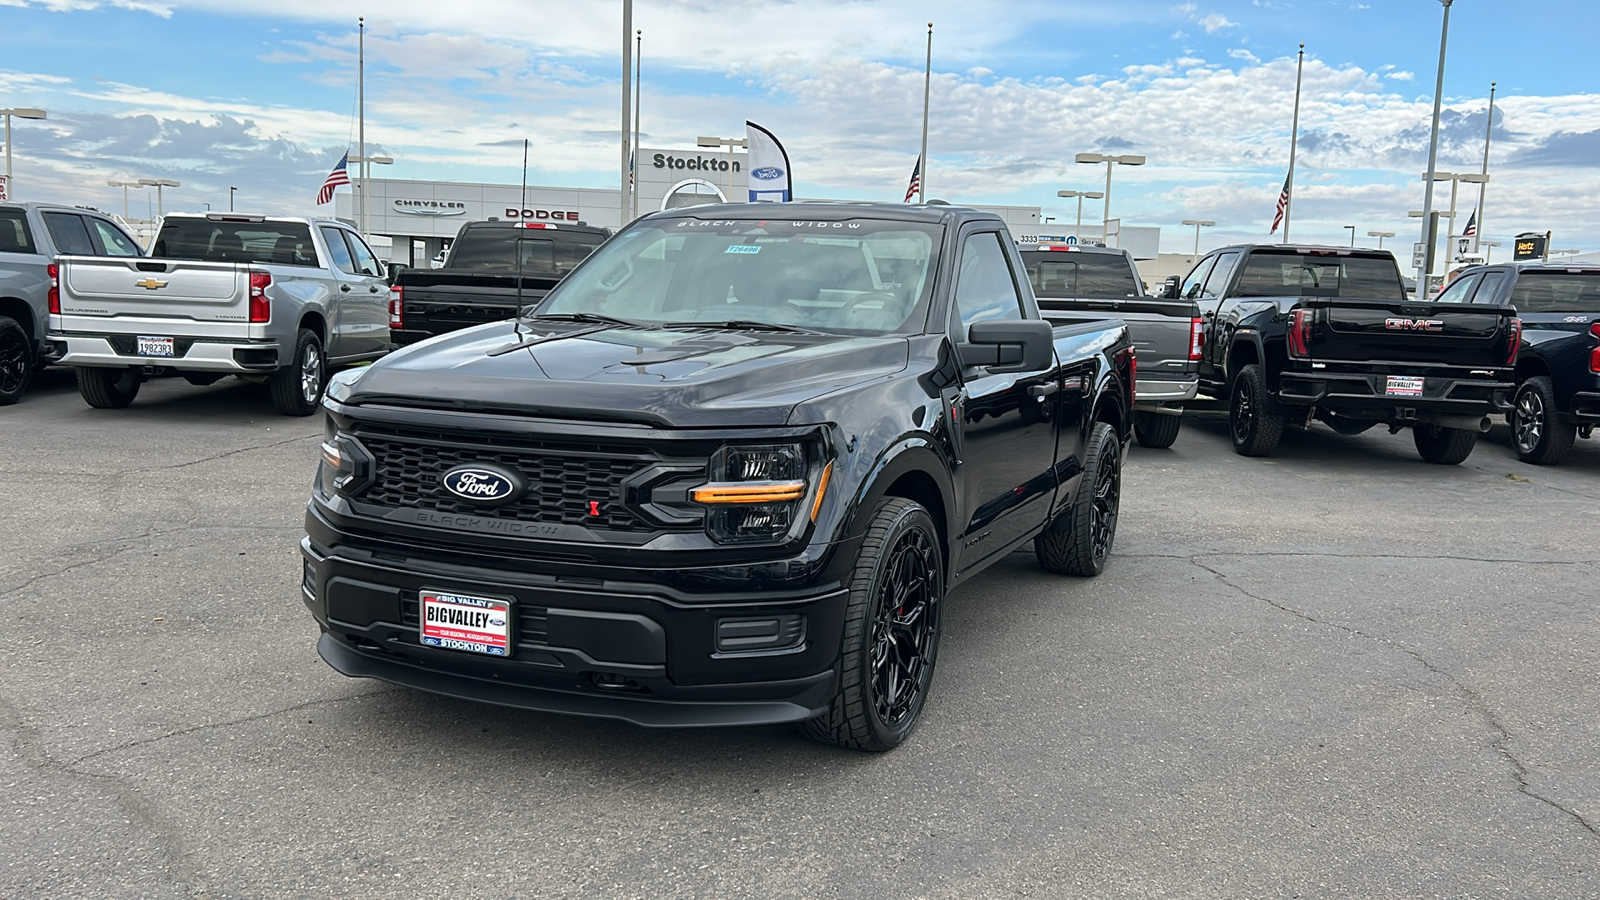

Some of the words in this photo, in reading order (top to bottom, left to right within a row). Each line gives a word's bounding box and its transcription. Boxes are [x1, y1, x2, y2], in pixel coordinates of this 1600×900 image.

[653, 153, 741, 172] Stockton
[394, 199, 465, 209] CHRYSLER
[505, 208, 579, 221] DODGE
[677, 220, 735, 228] BLACK
[792, 220, 861, 229] WIDOW
[1020, 235, 1038, 243] 3333
[1517, 242, 1535, 250] Hertz
[434, 306, 504, 316] PLATI
[1385, 318, 1443, 331] GMC
[456, 472, 500, 497] Ford
[416, 512, 480, 528] BLACK
[486, 520, 559, 535] WIDOW
[441, 595, 456, 603] BIG
[457, 597, 487, 607] VALLEY
[427, 606, 490, 629] BIGVALLEY
[440, 638, 487, 652] STOCKTON
